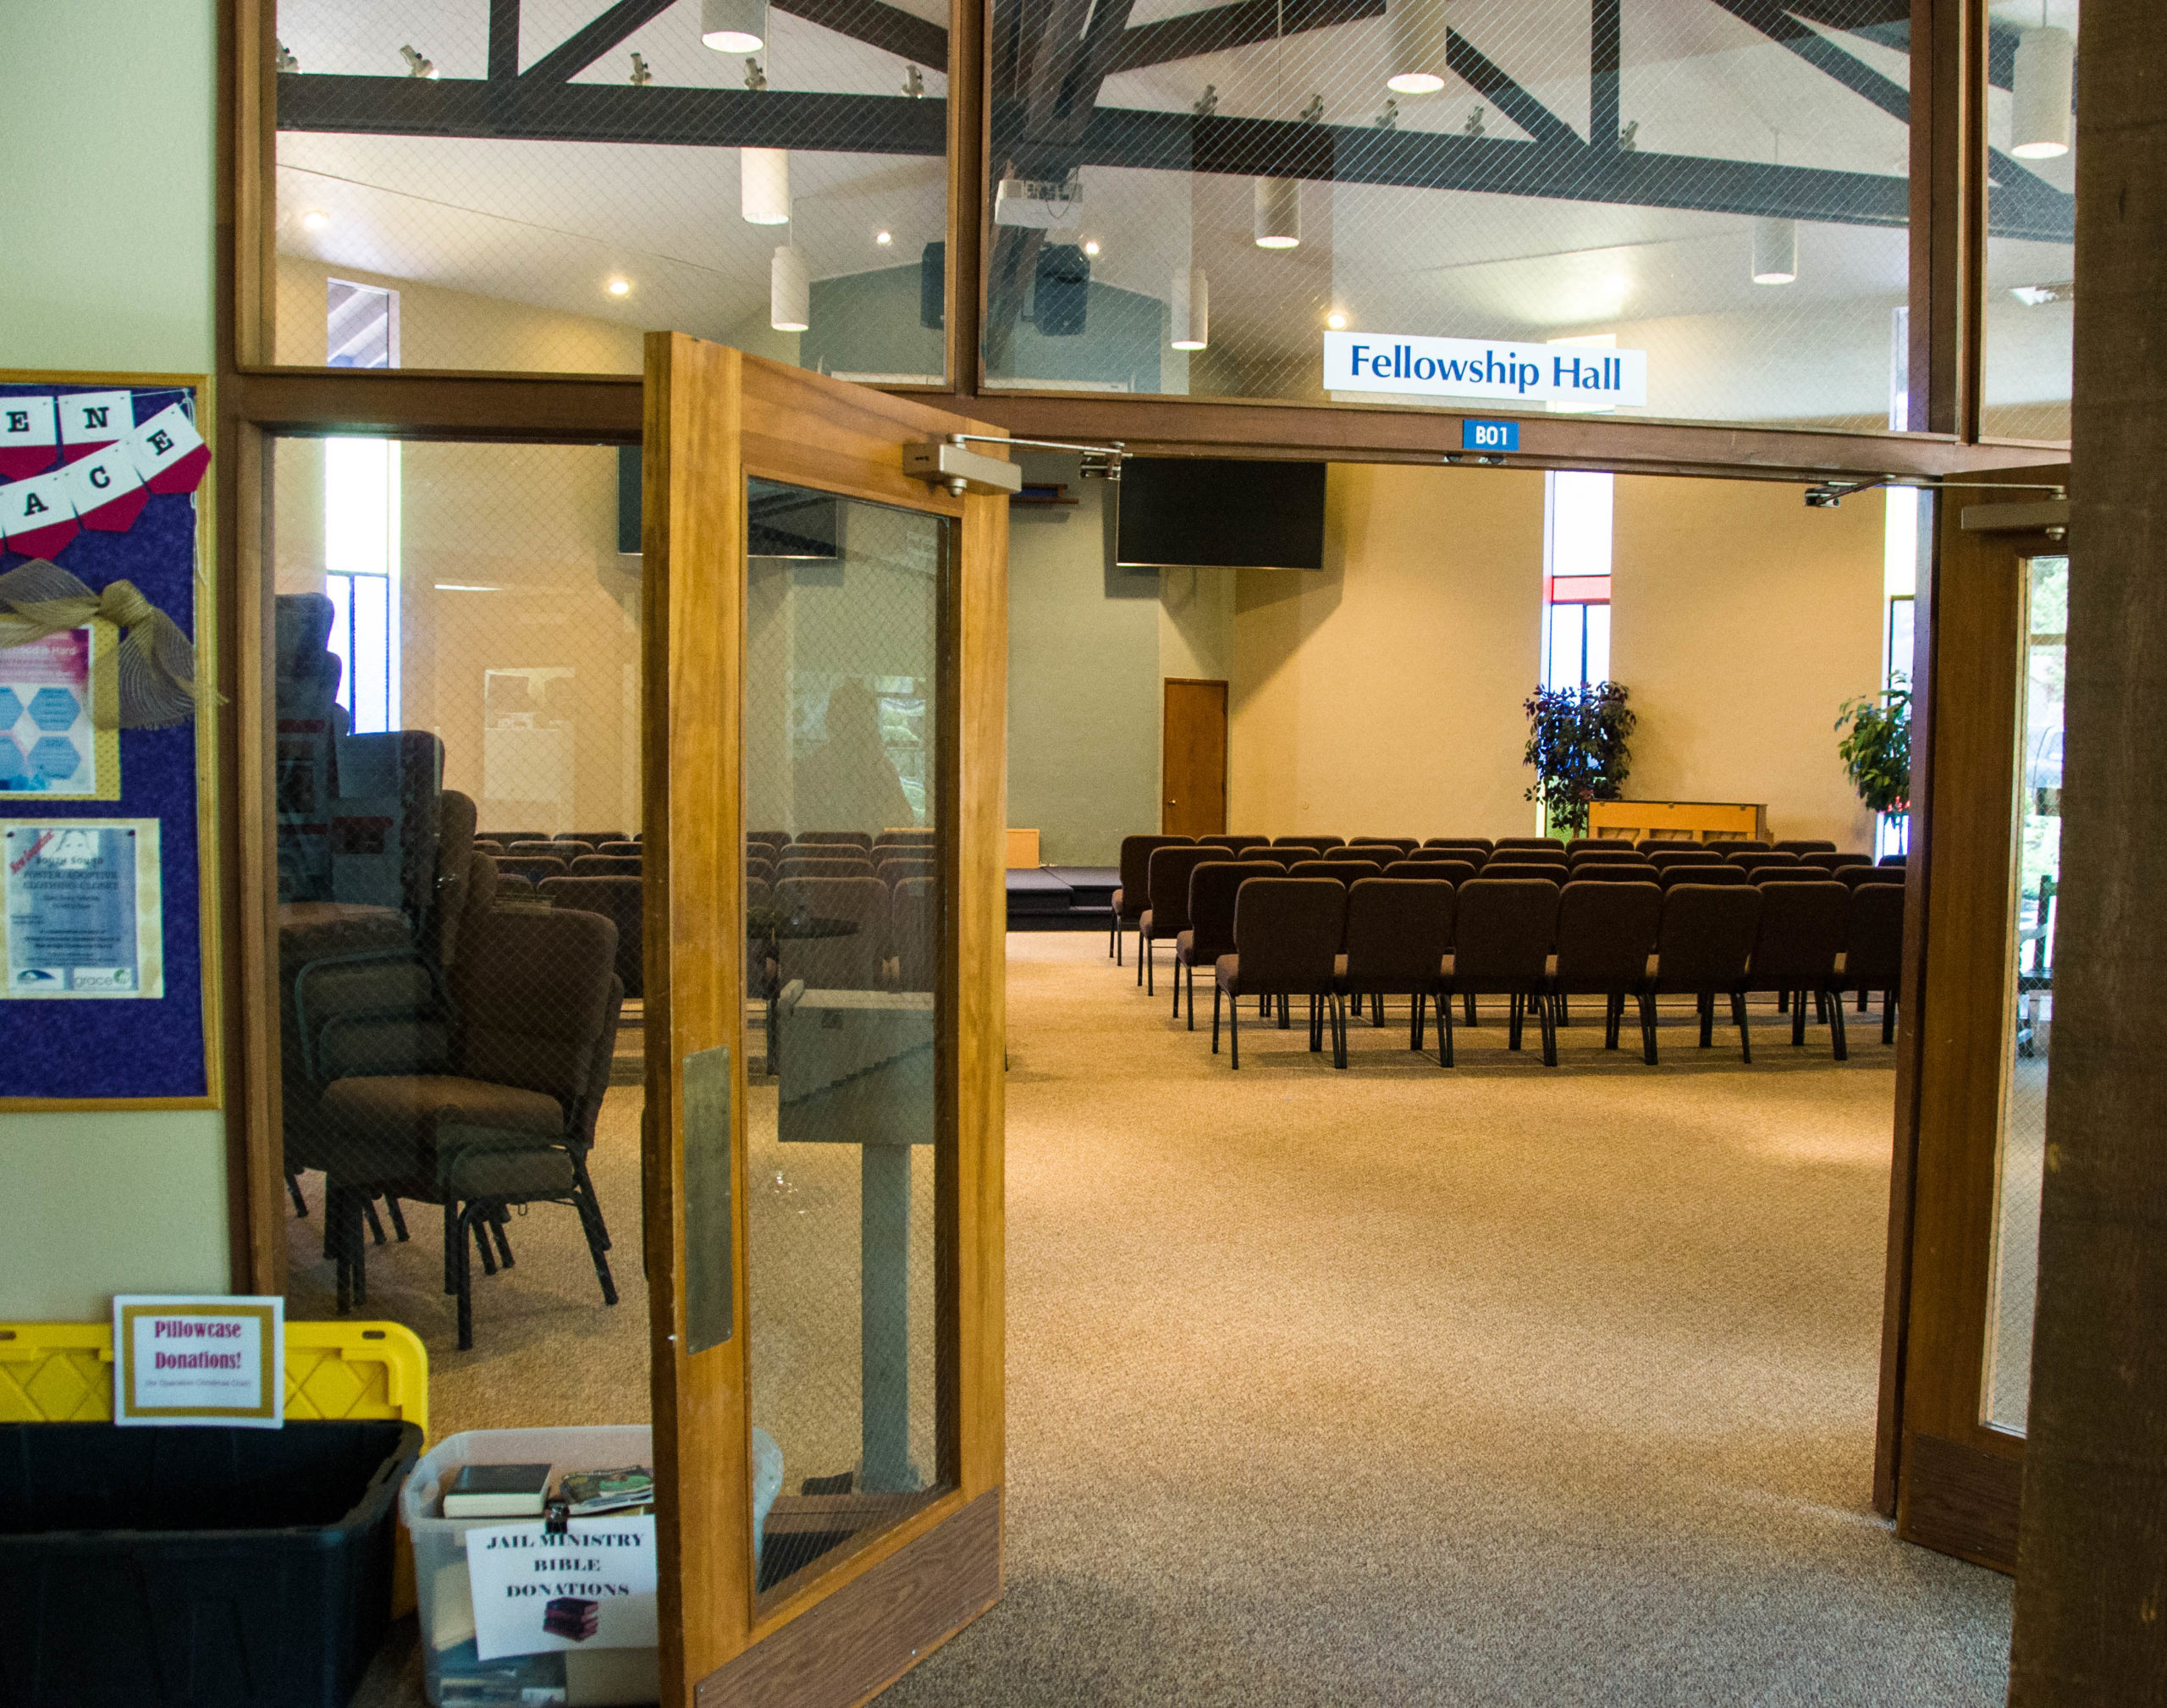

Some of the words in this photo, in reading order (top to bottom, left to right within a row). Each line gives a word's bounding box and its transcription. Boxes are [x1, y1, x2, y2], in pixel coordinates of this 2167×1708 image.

[1352, 344, 1540, 394] Fellowship
[1553, 355, 1621, 391] Hall
[155, 1320, 242, 1338] Pillowcase
[155, 1352, 241, 1369] Donations!
[486, 1534, 535, 1551] JAIL
[540, 1533, 644, 1549] MINISTRY
[534, 1558, 601, 1573] BIBLE
[506, 1584, 630, 1599] DONATIONS
